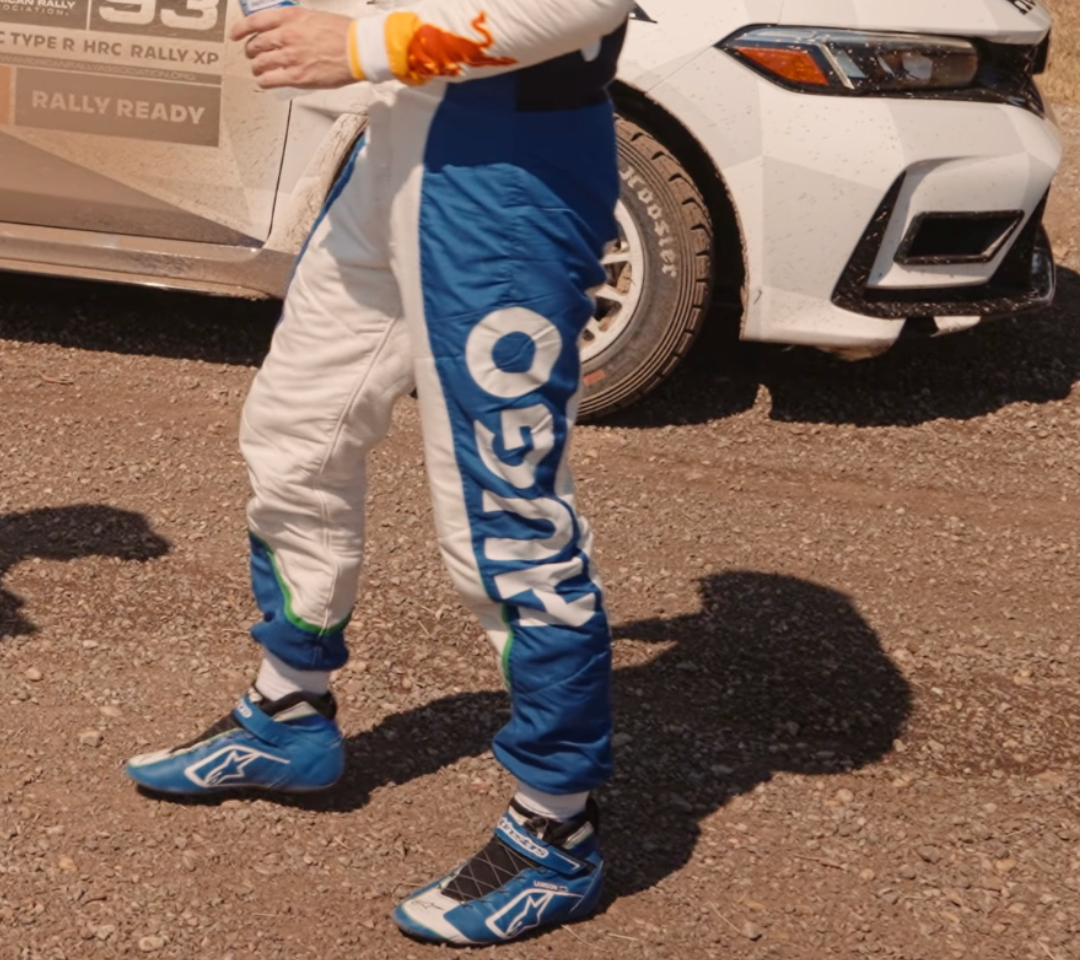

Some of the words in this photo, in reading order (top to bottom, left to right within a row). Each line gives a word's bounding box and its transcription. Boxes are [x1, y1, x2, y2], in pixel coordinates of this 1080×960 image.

[10, 32, 56, 49] TYPE
[63, 37, 75, 51] R
[83, 40, 122, 56] HRC
[131, 44, 188, 63] RALLY
[194, 50, 219, 65] XP
[32, 90, 110, 115] RALLY
[117, 99, 205, 124] READY
